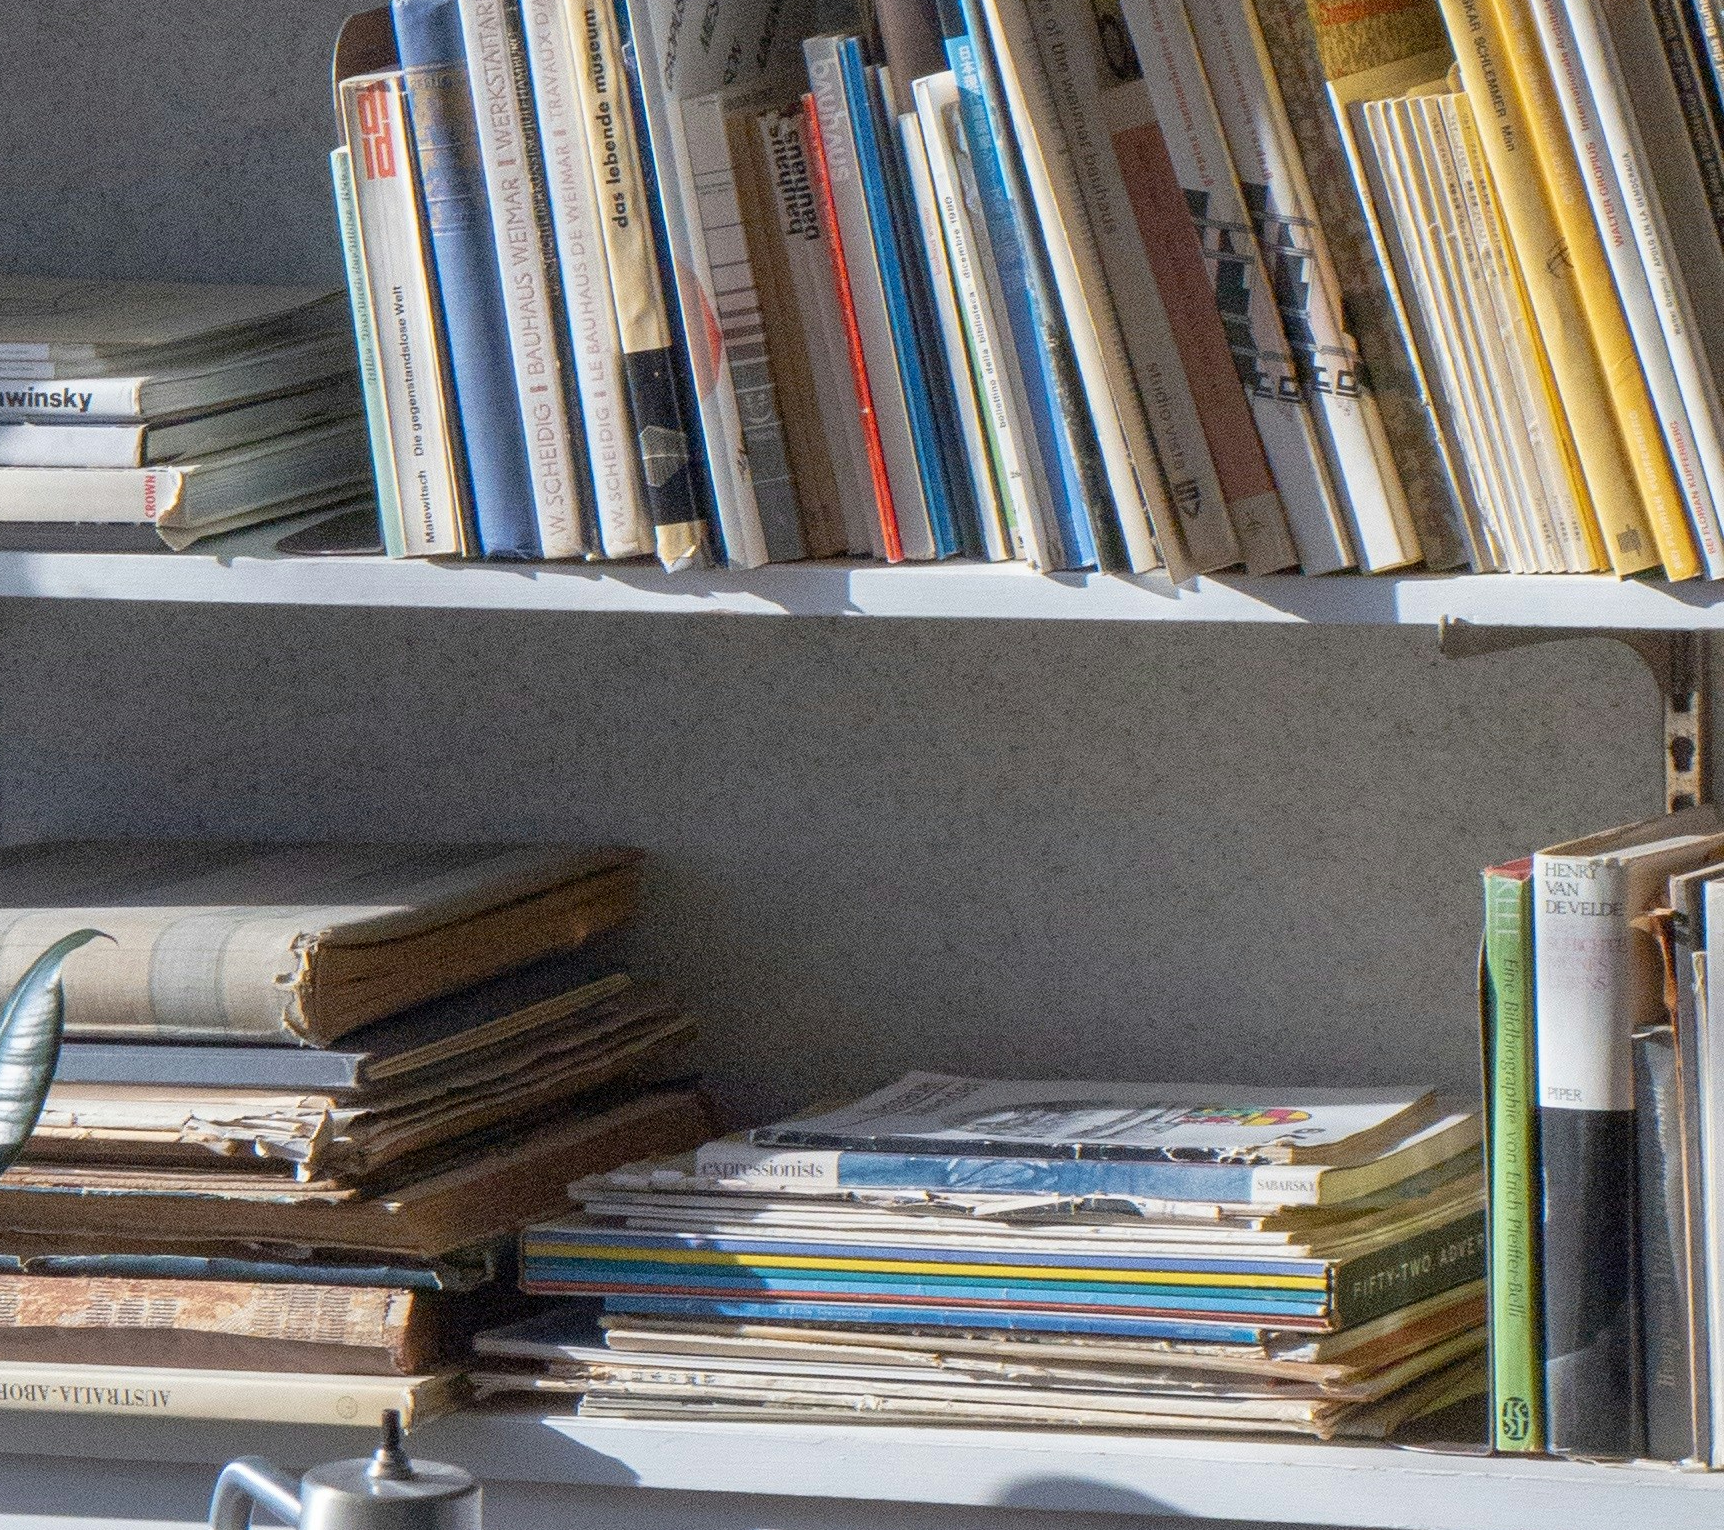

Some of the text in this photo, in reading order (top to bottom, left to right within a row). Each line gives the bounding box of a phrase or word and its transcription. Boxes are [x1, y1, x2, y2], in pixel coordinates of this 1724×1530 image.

[1043, 19, 1063, 37] of
[1049, 42, 1077, 72] the
[1056, 75, 1097, 150] weimar
[1473, 35, 1507, 119] SCHLEMMER
[580, 7, 629, 229] das lebende museum
[554, 143, 583, 225] WEIMAR
[767, 123, 805, 237] bauhaus
[1080, 153, 1121, 237] bauhaus
[1584, 141, 1612, 198] GROPIUS
[500, 178, 530, 266] WEIMAR
[567, 231, 585, 256] DE
[1601, 199, 1626, 249] WALTER
[390, 284, 408, 331] Welt
[514, 271, 544, 376] BAUHAUS
[572, 262, 600, 355] BAUHAUS
[397, 333, 427, 438] gegenstandslose
[587, 361, 602, 383] LE
[532, 402, 566, 506] SCHEIDIG
[596, 407, 626, 502] SCHEIDIG
[414, 468, 437, 545] Malewitsch
[1501, 958, 1520, 1002] Eine
[1506, 1116, 1519, 1143] von
[701, 1156, 825, 1181] expressionists
